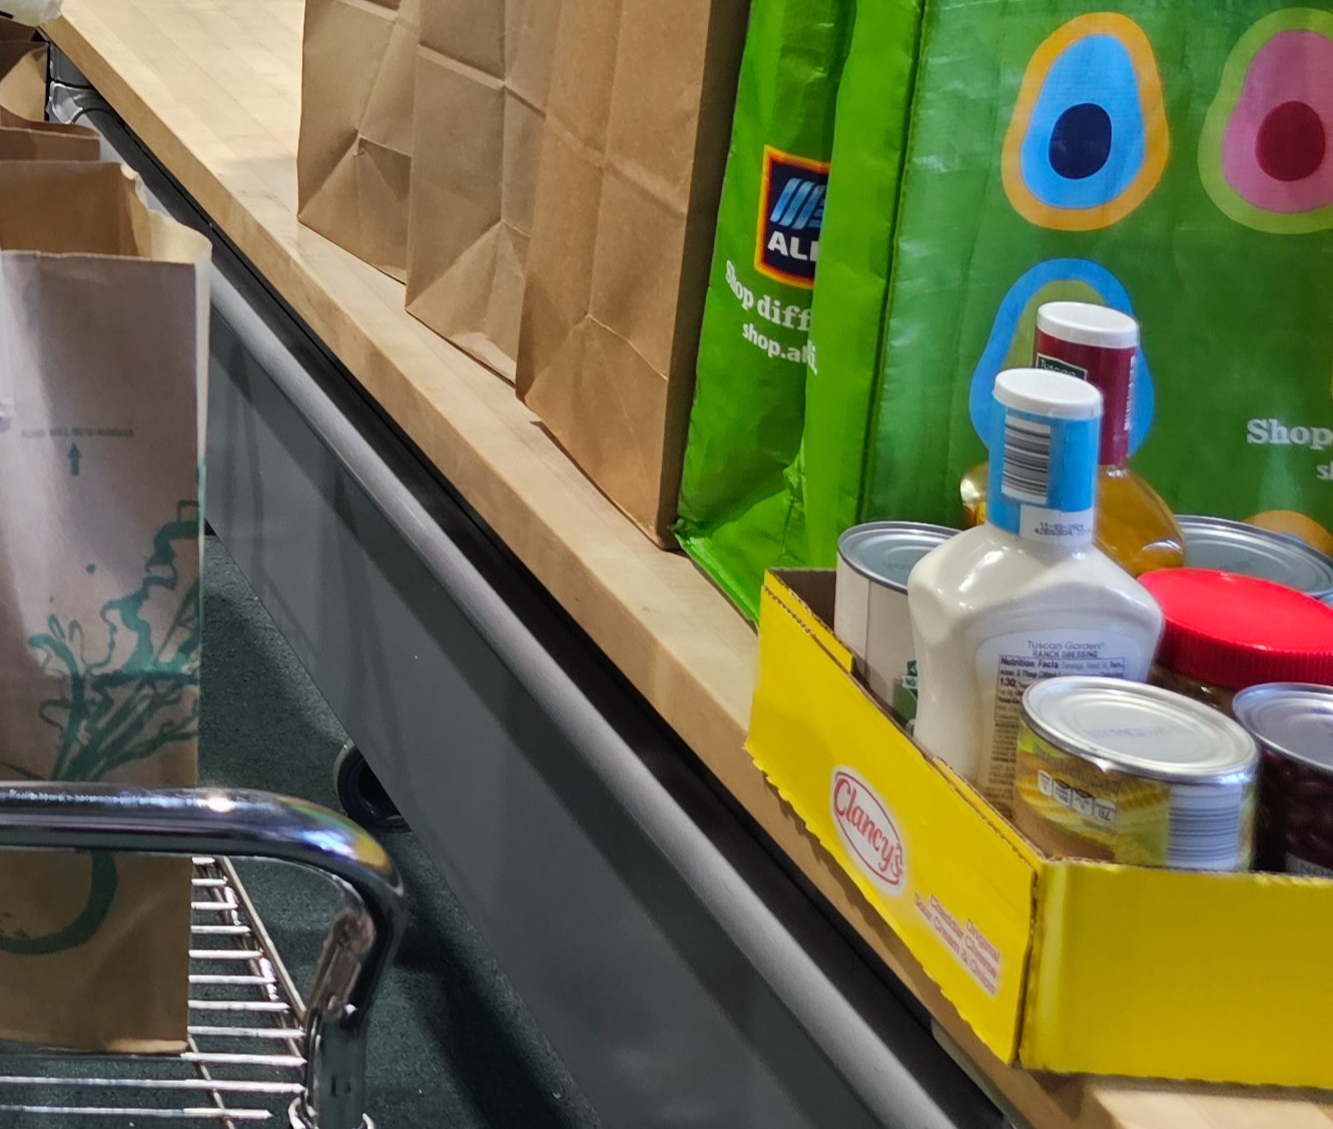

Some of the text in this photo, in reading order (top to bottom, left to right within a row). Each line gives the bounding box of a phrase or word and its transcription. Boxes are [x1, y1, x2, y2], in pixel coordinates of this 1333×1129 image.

[725, 260, 755, 311] Shop
[1247, 418, 1333, 450] Shop
[1027, 640, 1062, 650] Tuscan
[1032, 650, 1098, 659] RANCH DRESSING
[1000, 657, 1035, 668] Nutrition
[1038, 659, 1059, 668] Facts
[1000, 678, 1016, 687] 130
[833, 776, 904, 878] Clancy's
